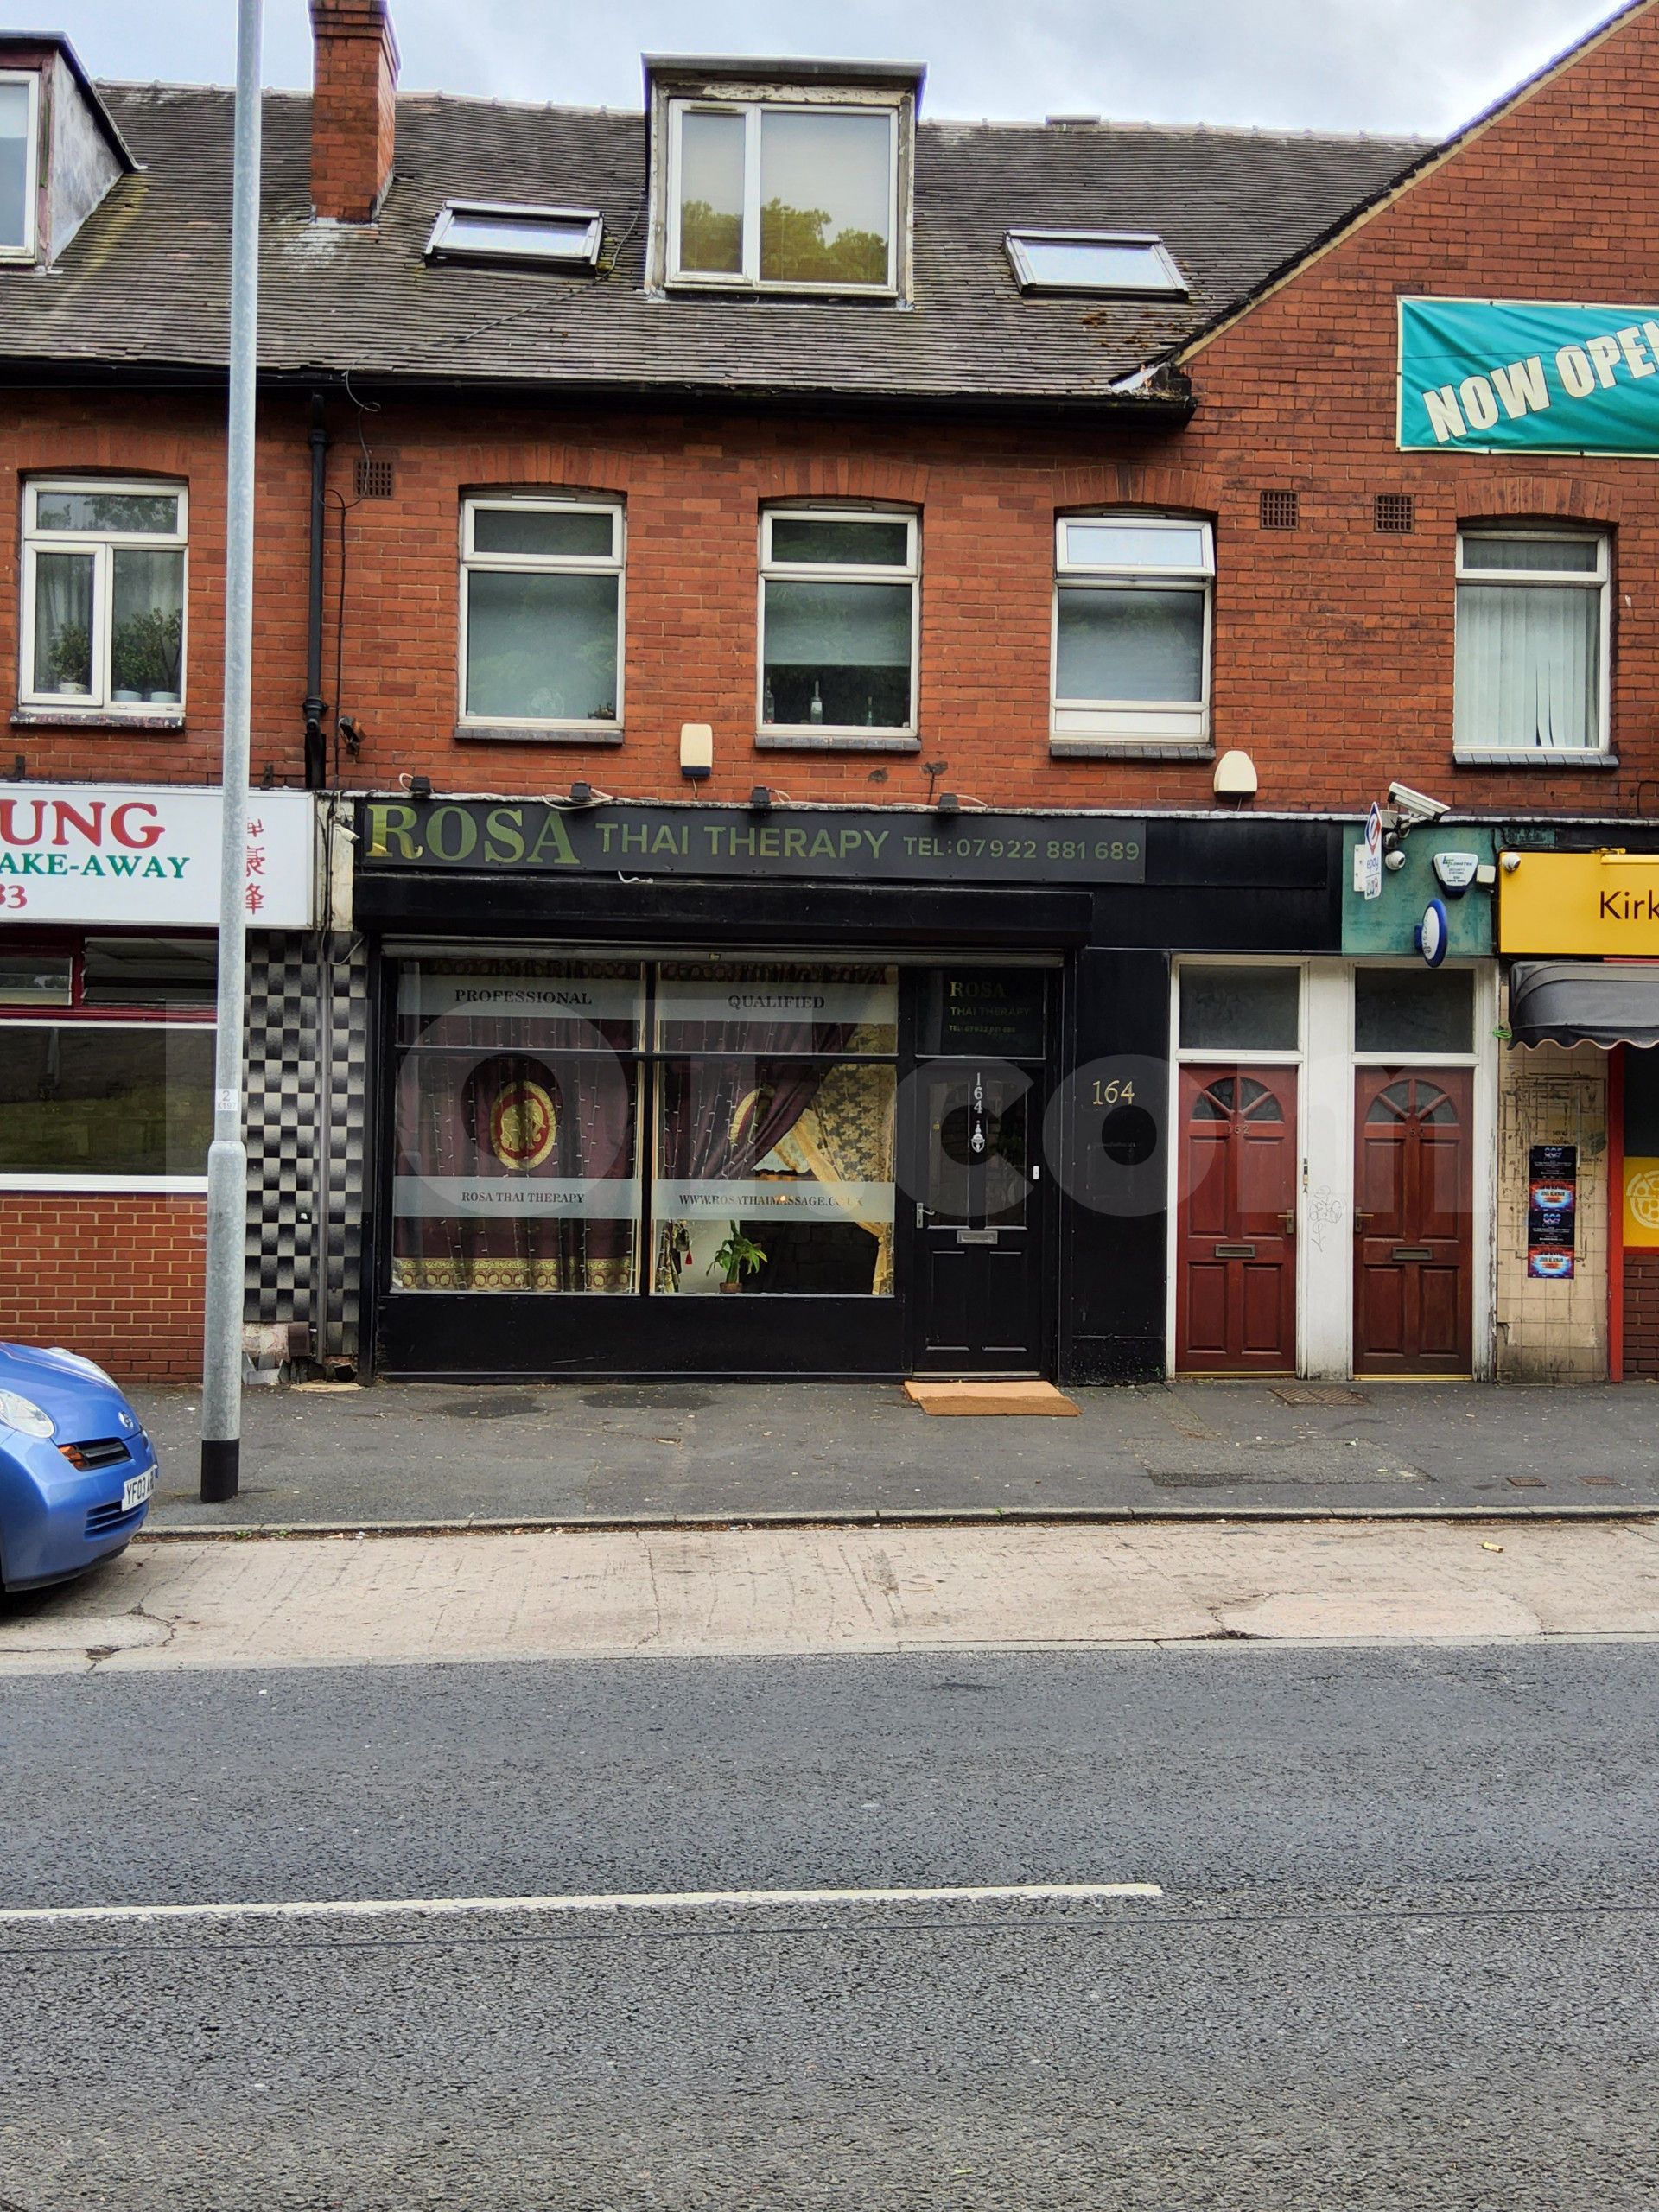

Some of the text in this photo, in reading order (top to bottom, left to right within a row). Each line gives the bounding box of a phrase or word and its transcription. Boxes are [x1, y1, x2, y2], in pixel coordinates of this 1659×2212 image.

[1422, 355, 1550, 443] NOW
[0, 799, 165, 849] UNG
[366, 804, 581, 864] ROSA
[595, 823, 689, 855] THAI
[703, 825, 889, 859] THERAPY
[1046, 840, 1086, 860] 881
[1095, 842, 1140, 861] 689
[0, 852, 190, 879] AKE-AWAY
[1599, 889, 1659, 920] Kirk
[454, 988, 593, 1005] PROFESSIONAL
[950, 981, 1005, 997] ROSA
[728, 995, 825, 1010] QUALIFIED
[950, 1007, 976, 1017] THAI
[222, 1090, 231, 1102] 2
[1092, 1079, 1135, 1106] 164
[461, 1192, 585, 1203] ROSA THAI THERAPY
